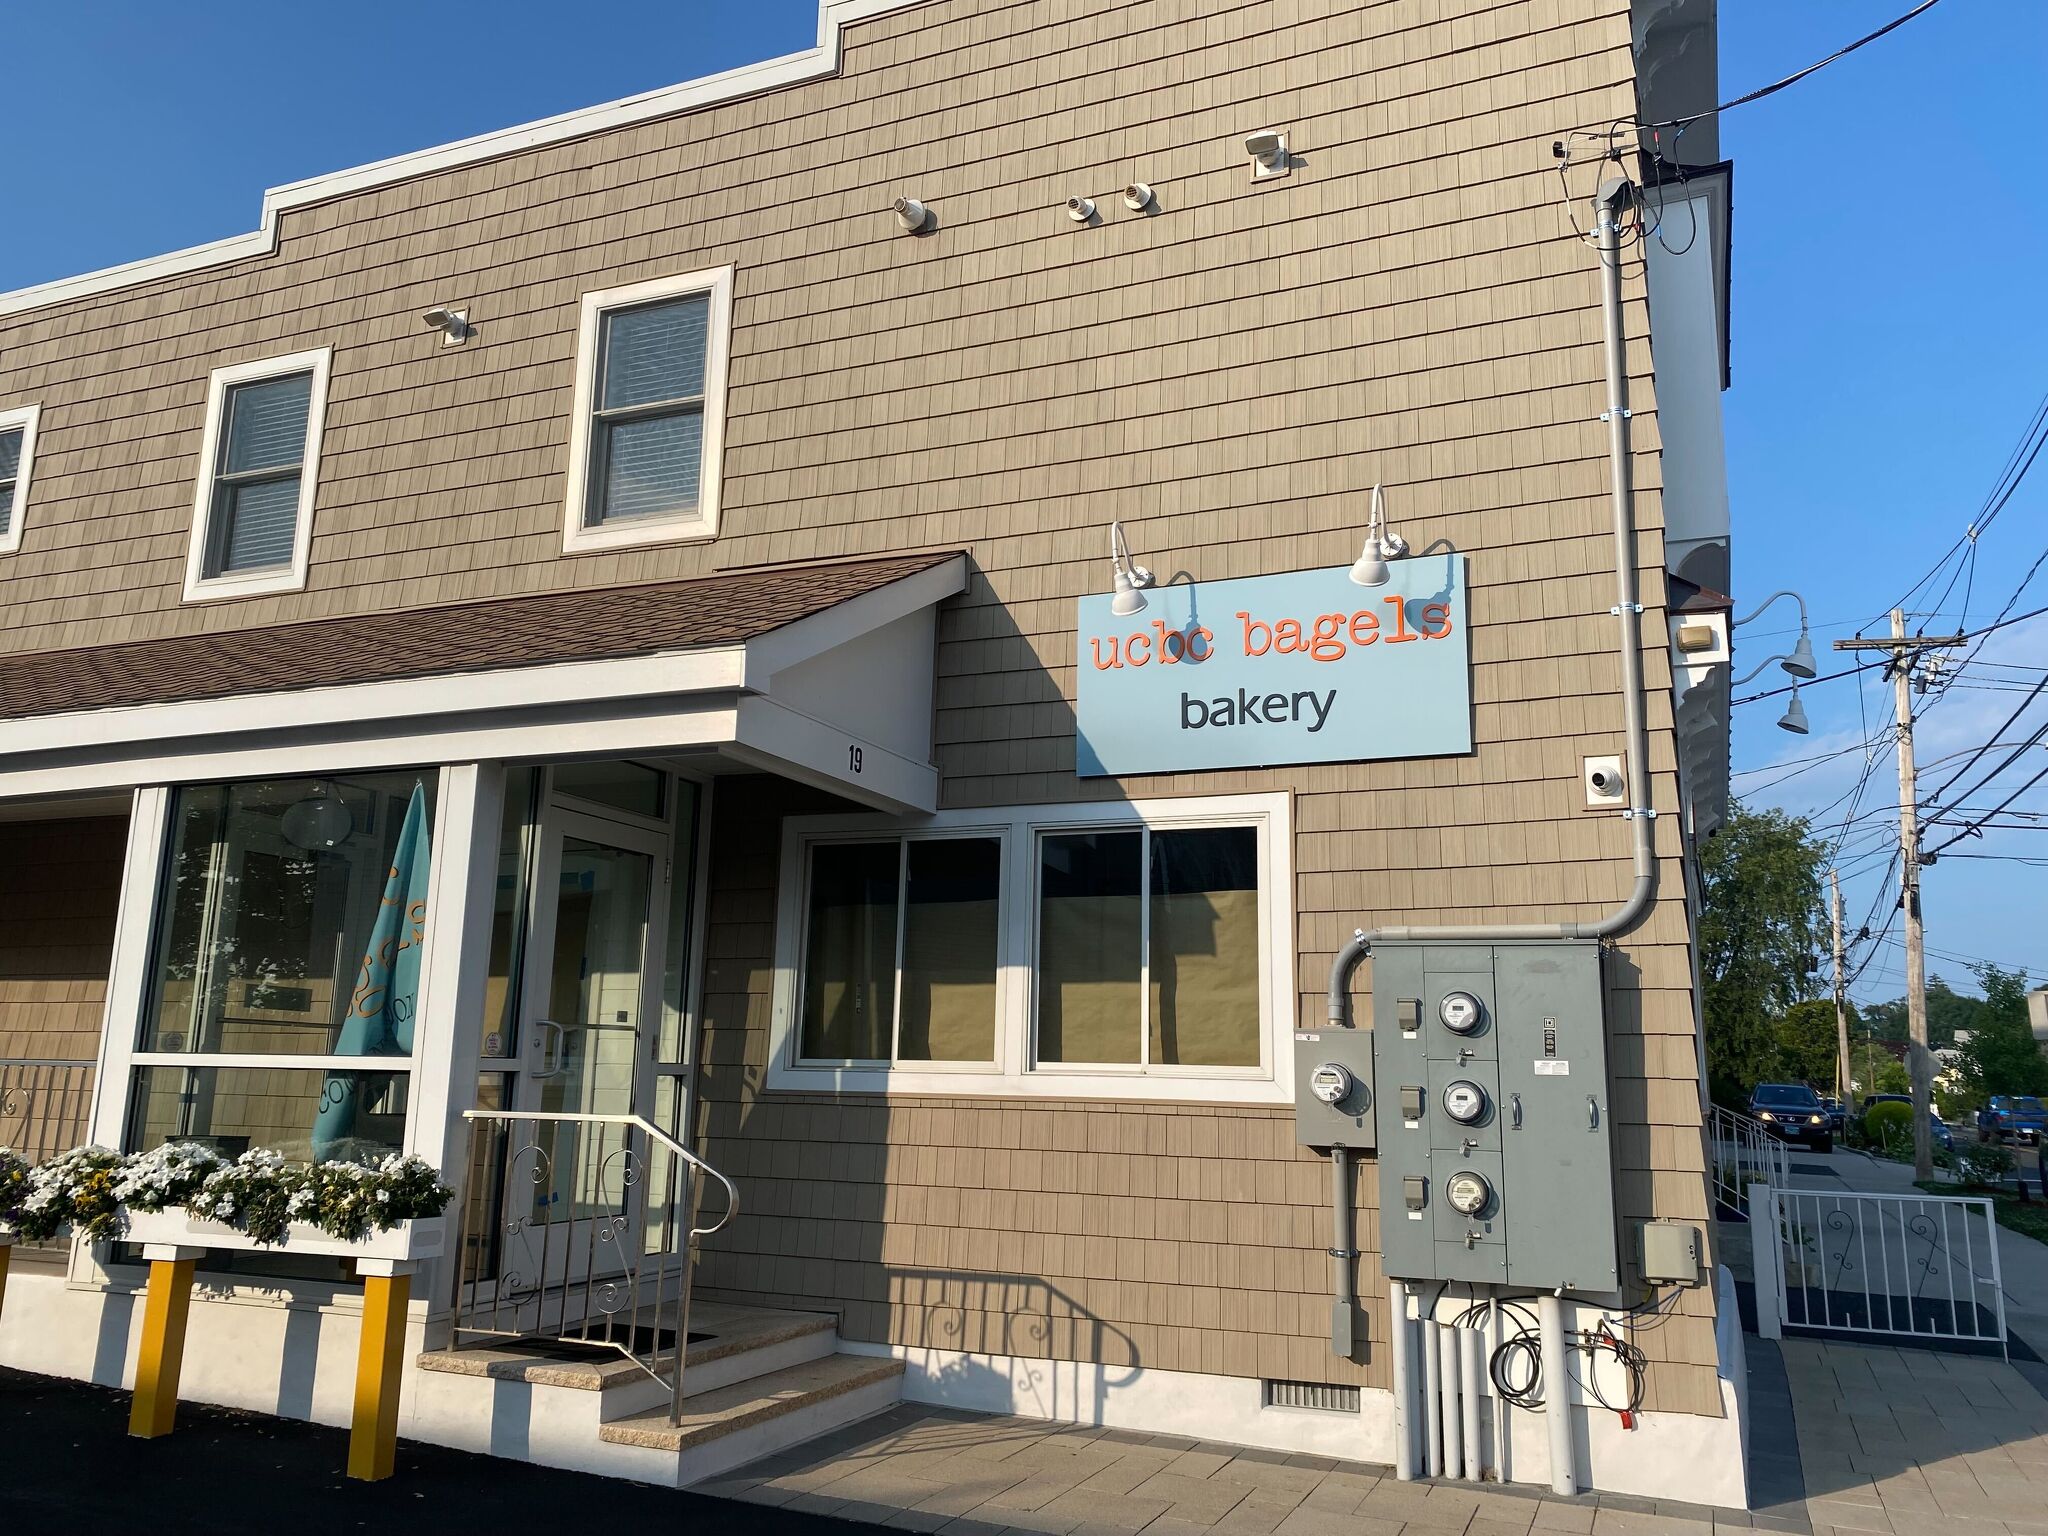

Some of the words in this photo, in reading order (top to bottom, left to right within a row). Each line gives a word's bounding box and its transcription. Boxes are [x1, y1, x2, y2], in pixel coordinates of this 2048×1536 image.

[1089, 619, 1214, 670] ucbc
[1236, 594, 1453, 662] bagels
[1181, 687, 1337, 732] bakery
[849, 744, 862, 773] 19
